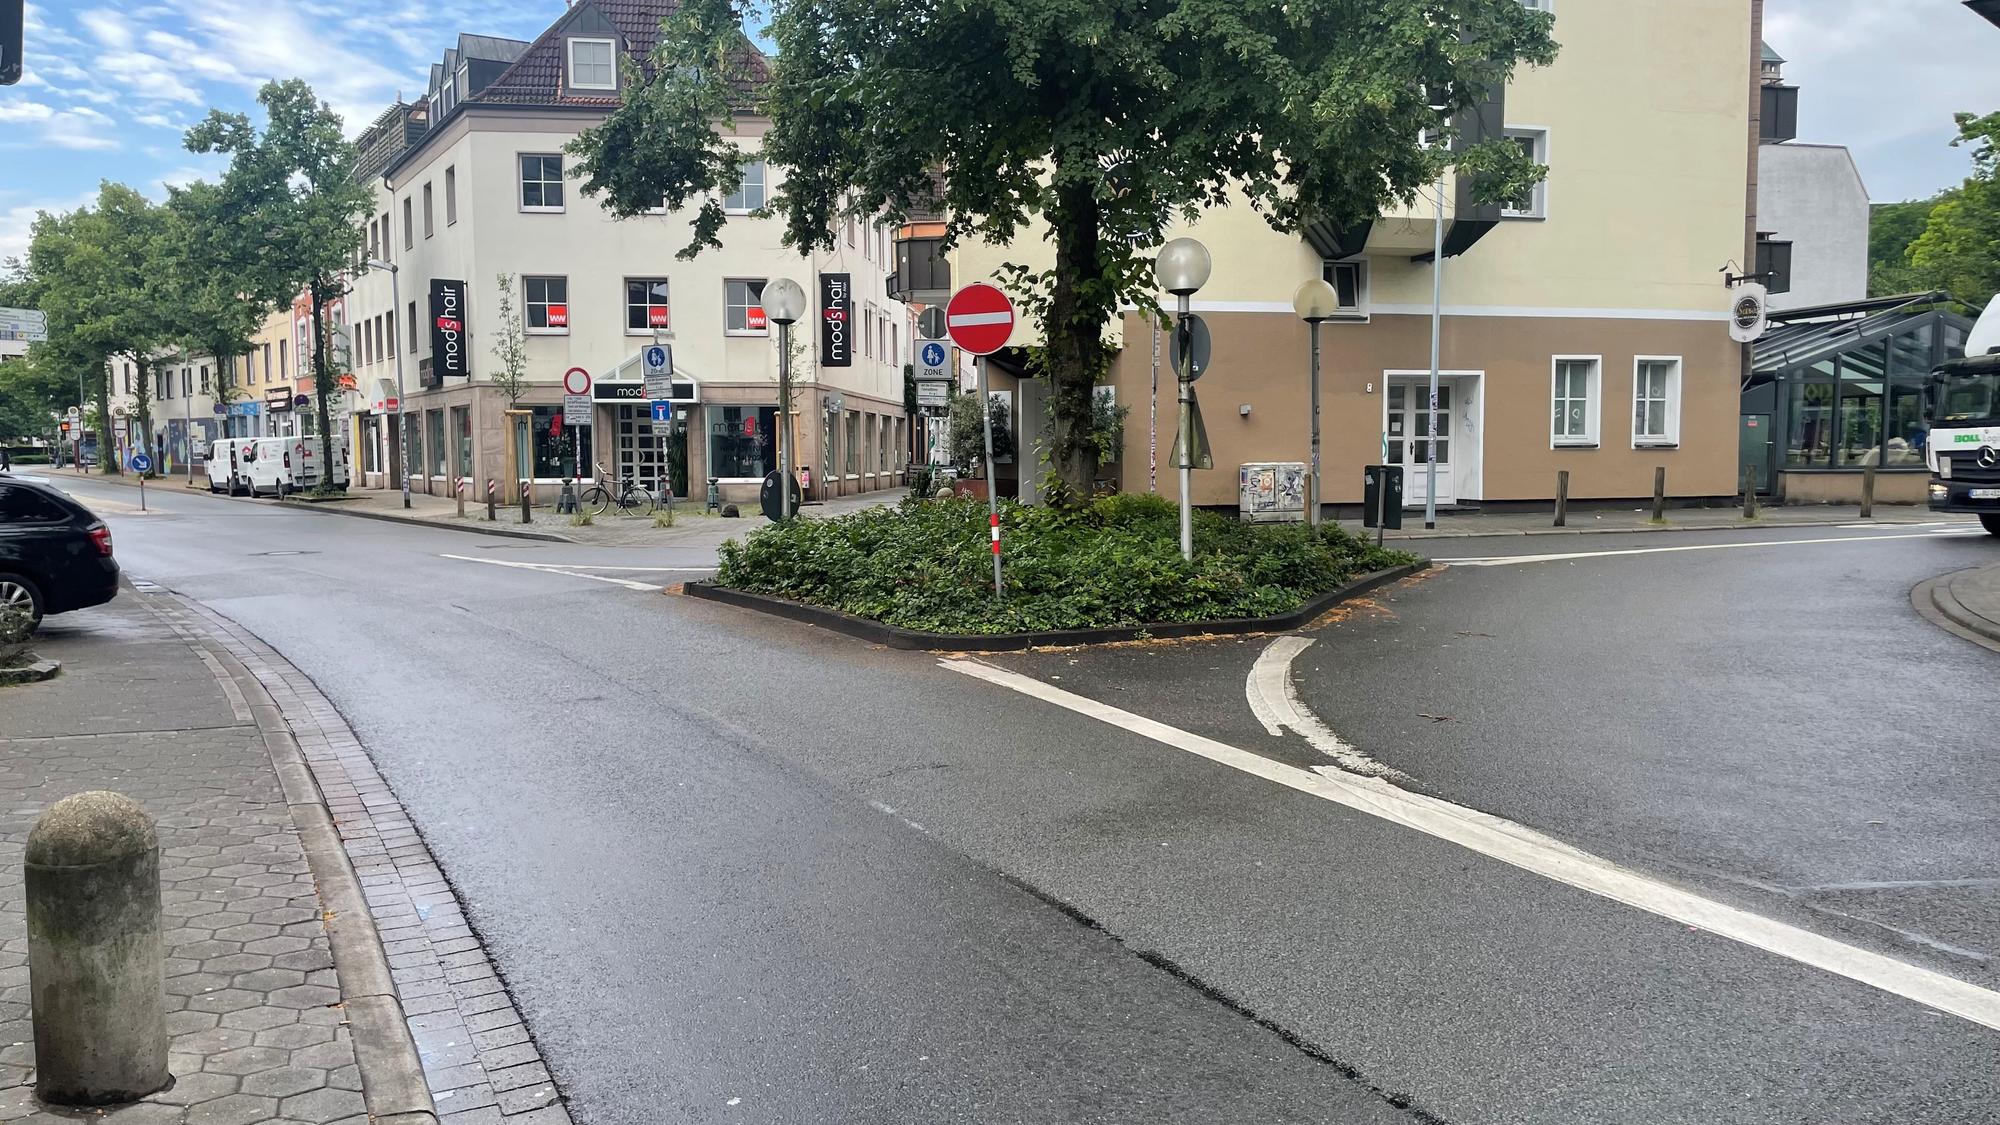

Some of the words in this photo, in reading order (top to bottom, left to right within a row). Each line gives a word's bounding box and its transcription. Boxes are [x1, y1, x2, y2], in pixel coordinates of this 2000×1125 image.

[827, 279, 843, 309] hair
[440, 285, 456, 318] hair
[923, 368, 943, 376] ZONE
[1366, 382, 1373, 392] 8
[1953, 434, 1981, 443] BOLL
